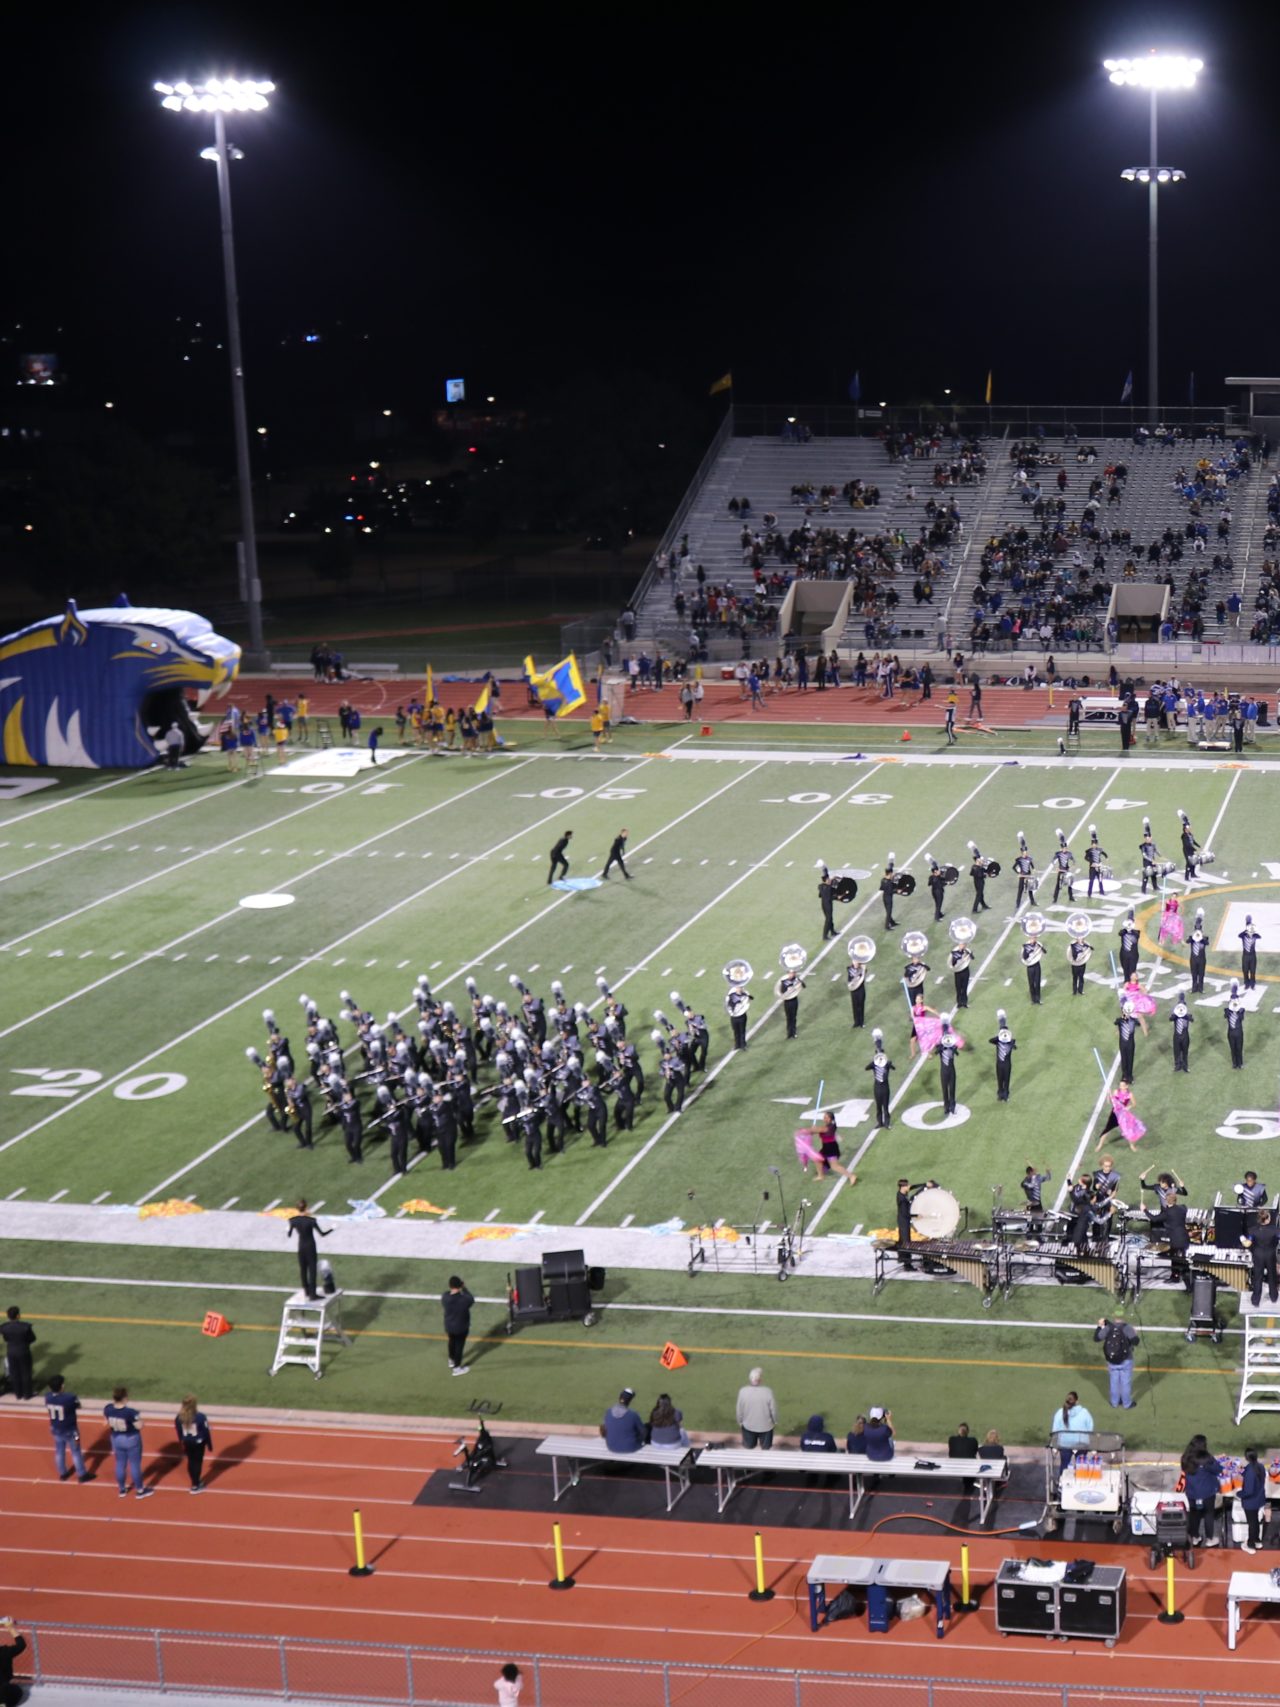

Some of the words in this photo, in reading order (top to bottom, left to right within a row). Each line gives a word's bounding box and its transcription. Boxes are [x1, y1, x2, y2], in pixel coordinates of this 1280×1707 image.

[539, 786, 648, 800] 20
[787, 792, 894, 805] 30
[1042, 797, 1149, 811] 40
[10, 1067, 188, 1101] 20
[799, 1097, 972, 1131] 40
[203, 1314, 219, 1334] 30
[661, 1343, 675, 1366] 40
